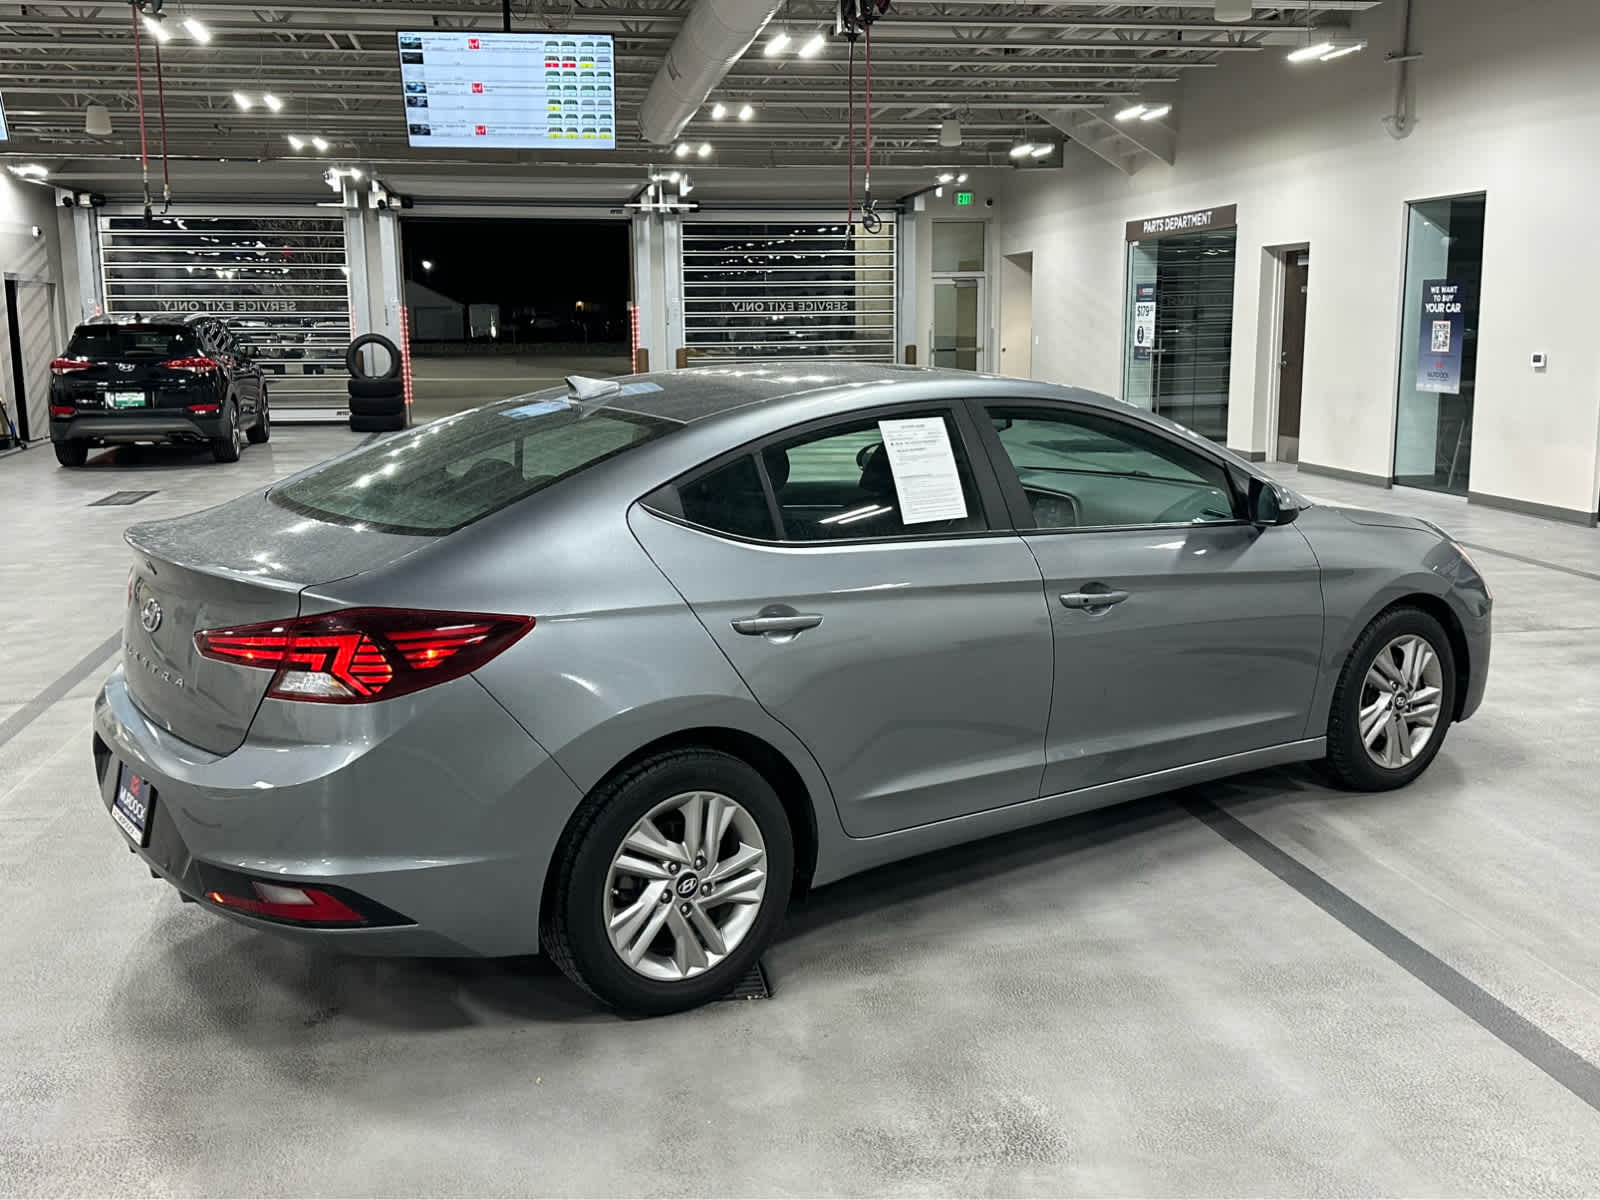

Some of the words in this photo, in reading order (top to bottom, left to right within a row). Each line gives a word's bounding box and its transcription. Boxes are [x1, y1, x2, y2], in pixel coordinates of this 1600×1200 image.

[957, 193, 972, 205] EXIT
[1143, 219, 1164, 233] PARTS
[1165, 211, 1212, 231] DEPARTMENT
[1433, 294, 1441, 302] TO
[1442, 294, 1454, 302] BUY
[1425, 303, 1445, 313] YOUR
[1446, 303, 1461, 313] CAR
